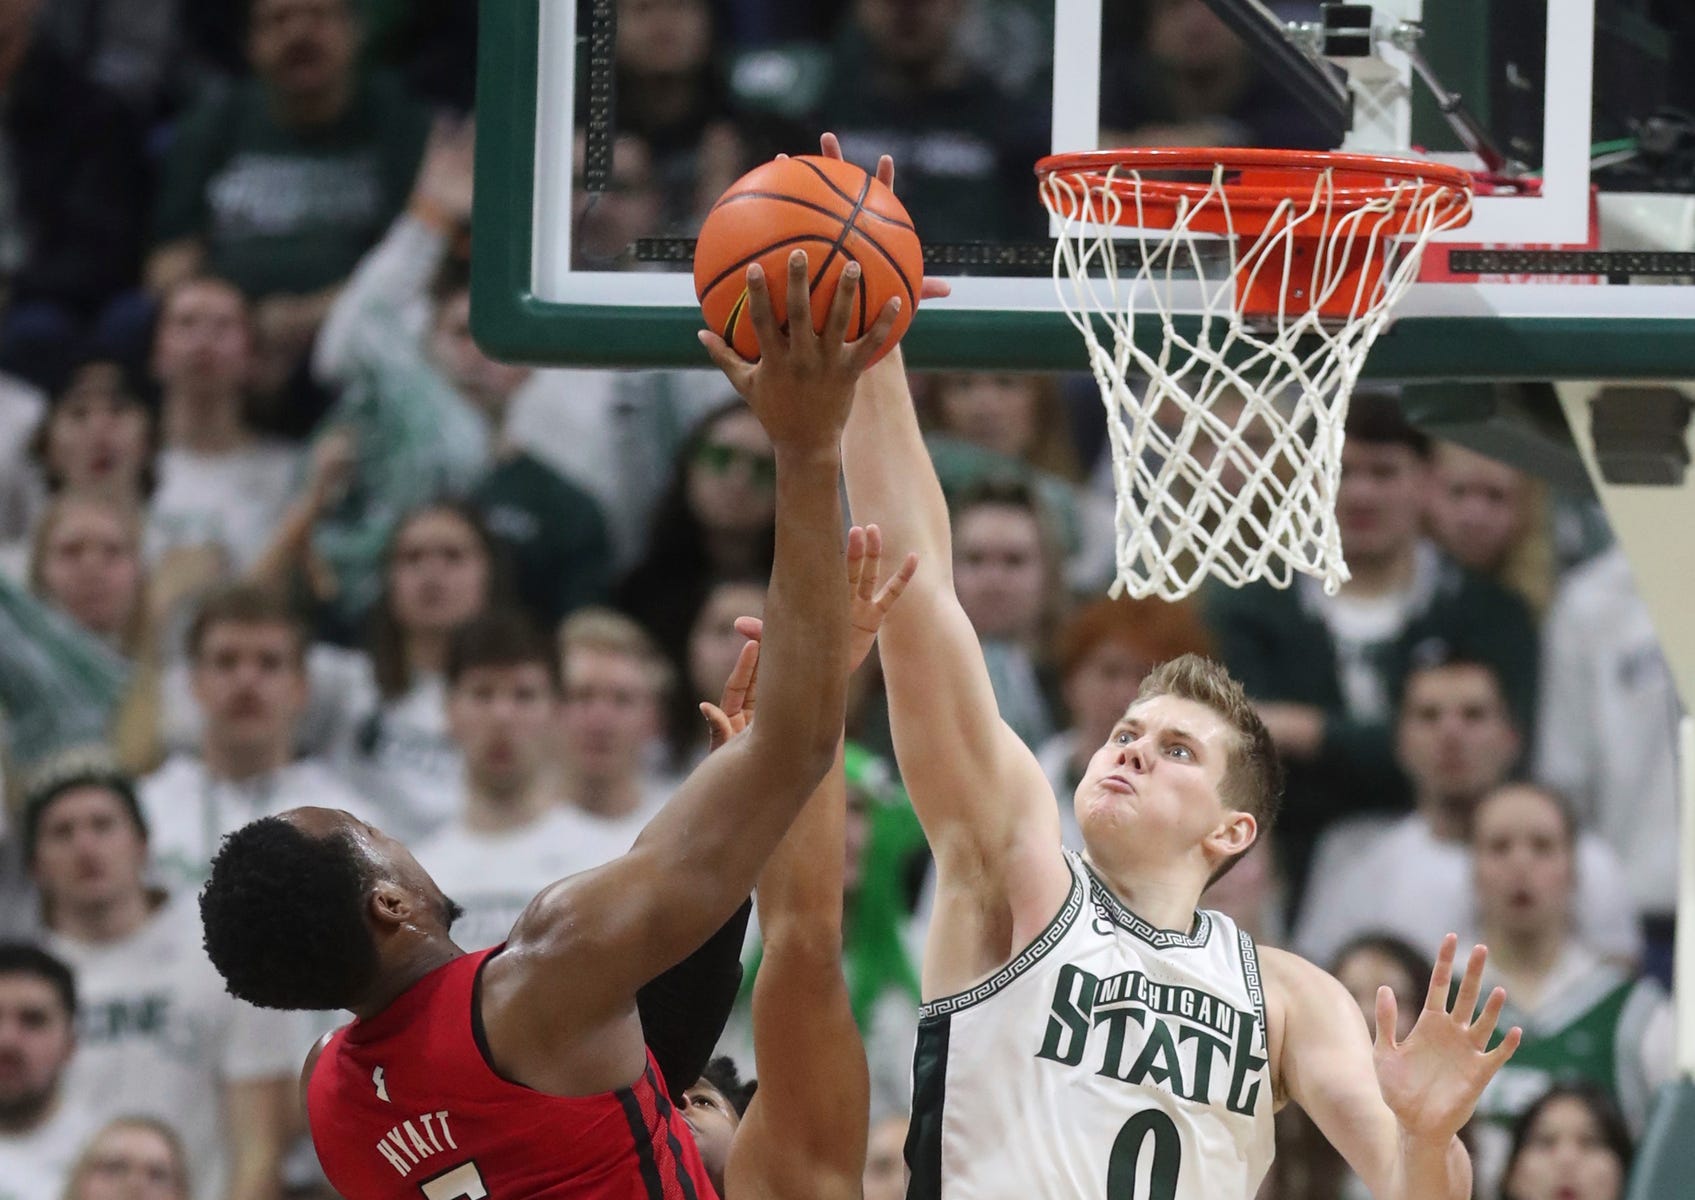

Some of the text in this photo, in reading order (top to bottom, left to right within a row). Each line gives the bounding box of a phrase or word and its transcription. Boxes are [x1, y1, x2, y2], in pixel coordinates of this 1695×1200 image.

[1099, 972, 1233, 1037] MICHIGAN
[1034, 962, 1269, 1118] STATE
[376, 1110, 458, 1178] HYATT
